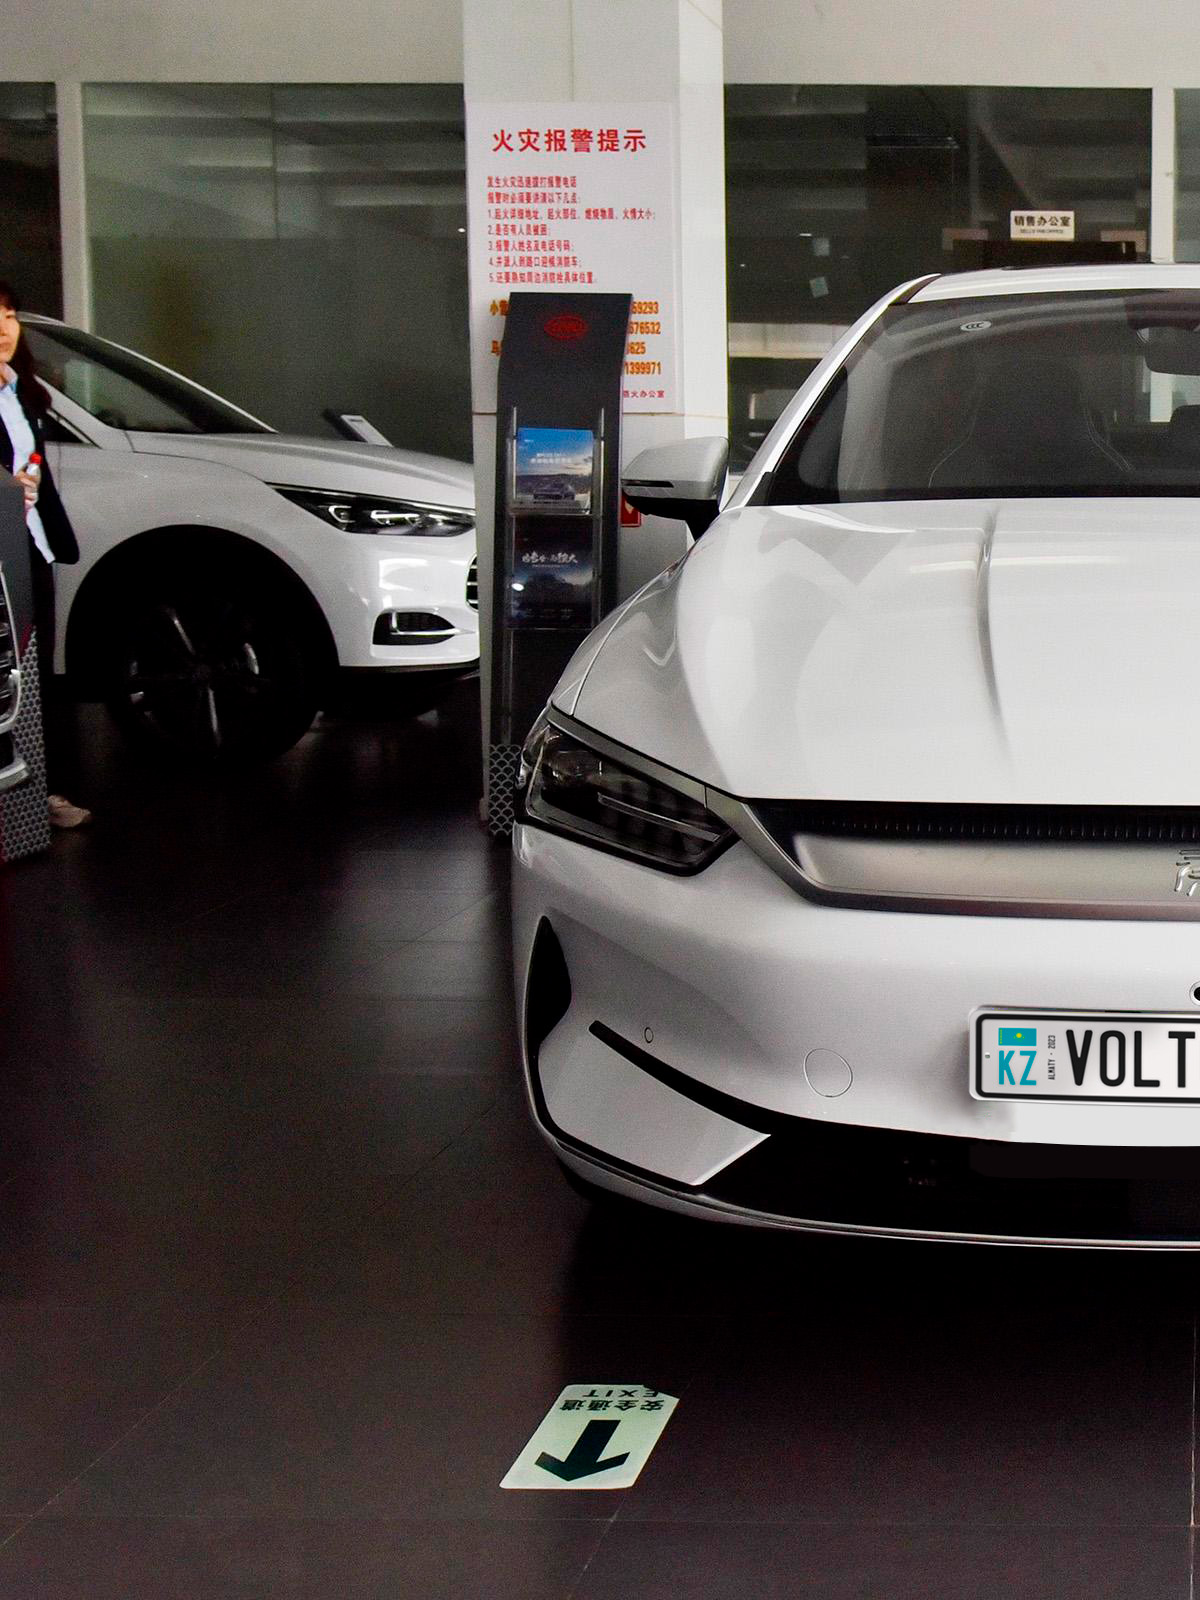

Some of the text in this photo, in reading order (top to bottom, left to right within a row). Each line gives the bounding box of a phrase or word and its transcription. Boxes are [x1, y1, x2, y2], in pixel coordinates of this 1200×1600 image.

[493, 128, 646, 152] 火灾报警提示
[1014, 215, 1071, 227] 销售办公室
[1048, 1035, 1056, 1080] ALMATY 2023
[999, 1050, 1037, 1086] KZ
[582, 1389, 659, 1397] EXIT
[560, 1400, 665, 1411] 安全通道
